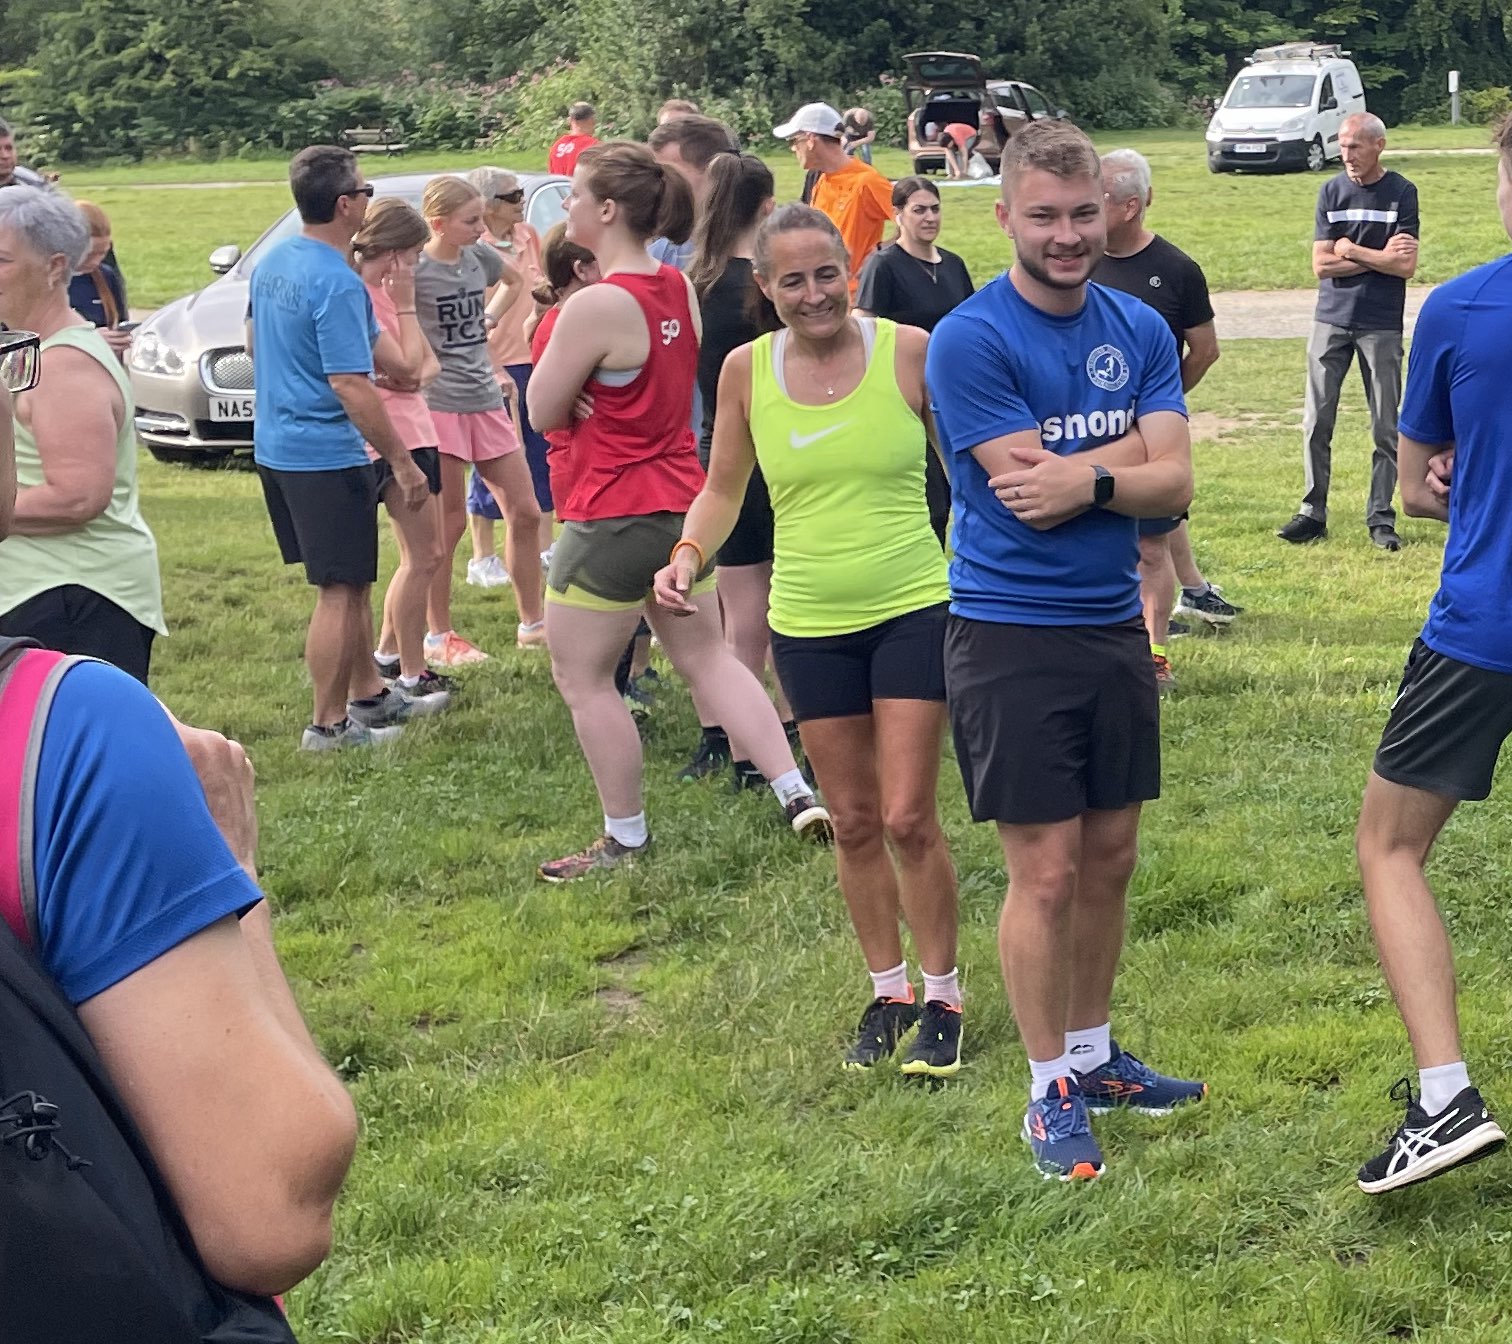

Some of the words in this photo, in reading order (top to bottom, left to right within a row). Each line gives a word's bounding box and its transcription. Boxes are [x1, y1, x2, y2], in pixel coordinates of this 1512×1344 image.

[438, 298, 486, 322] RUN
[661, 319, 680, 346] 50
[218, 400, 256, 417] NA5
